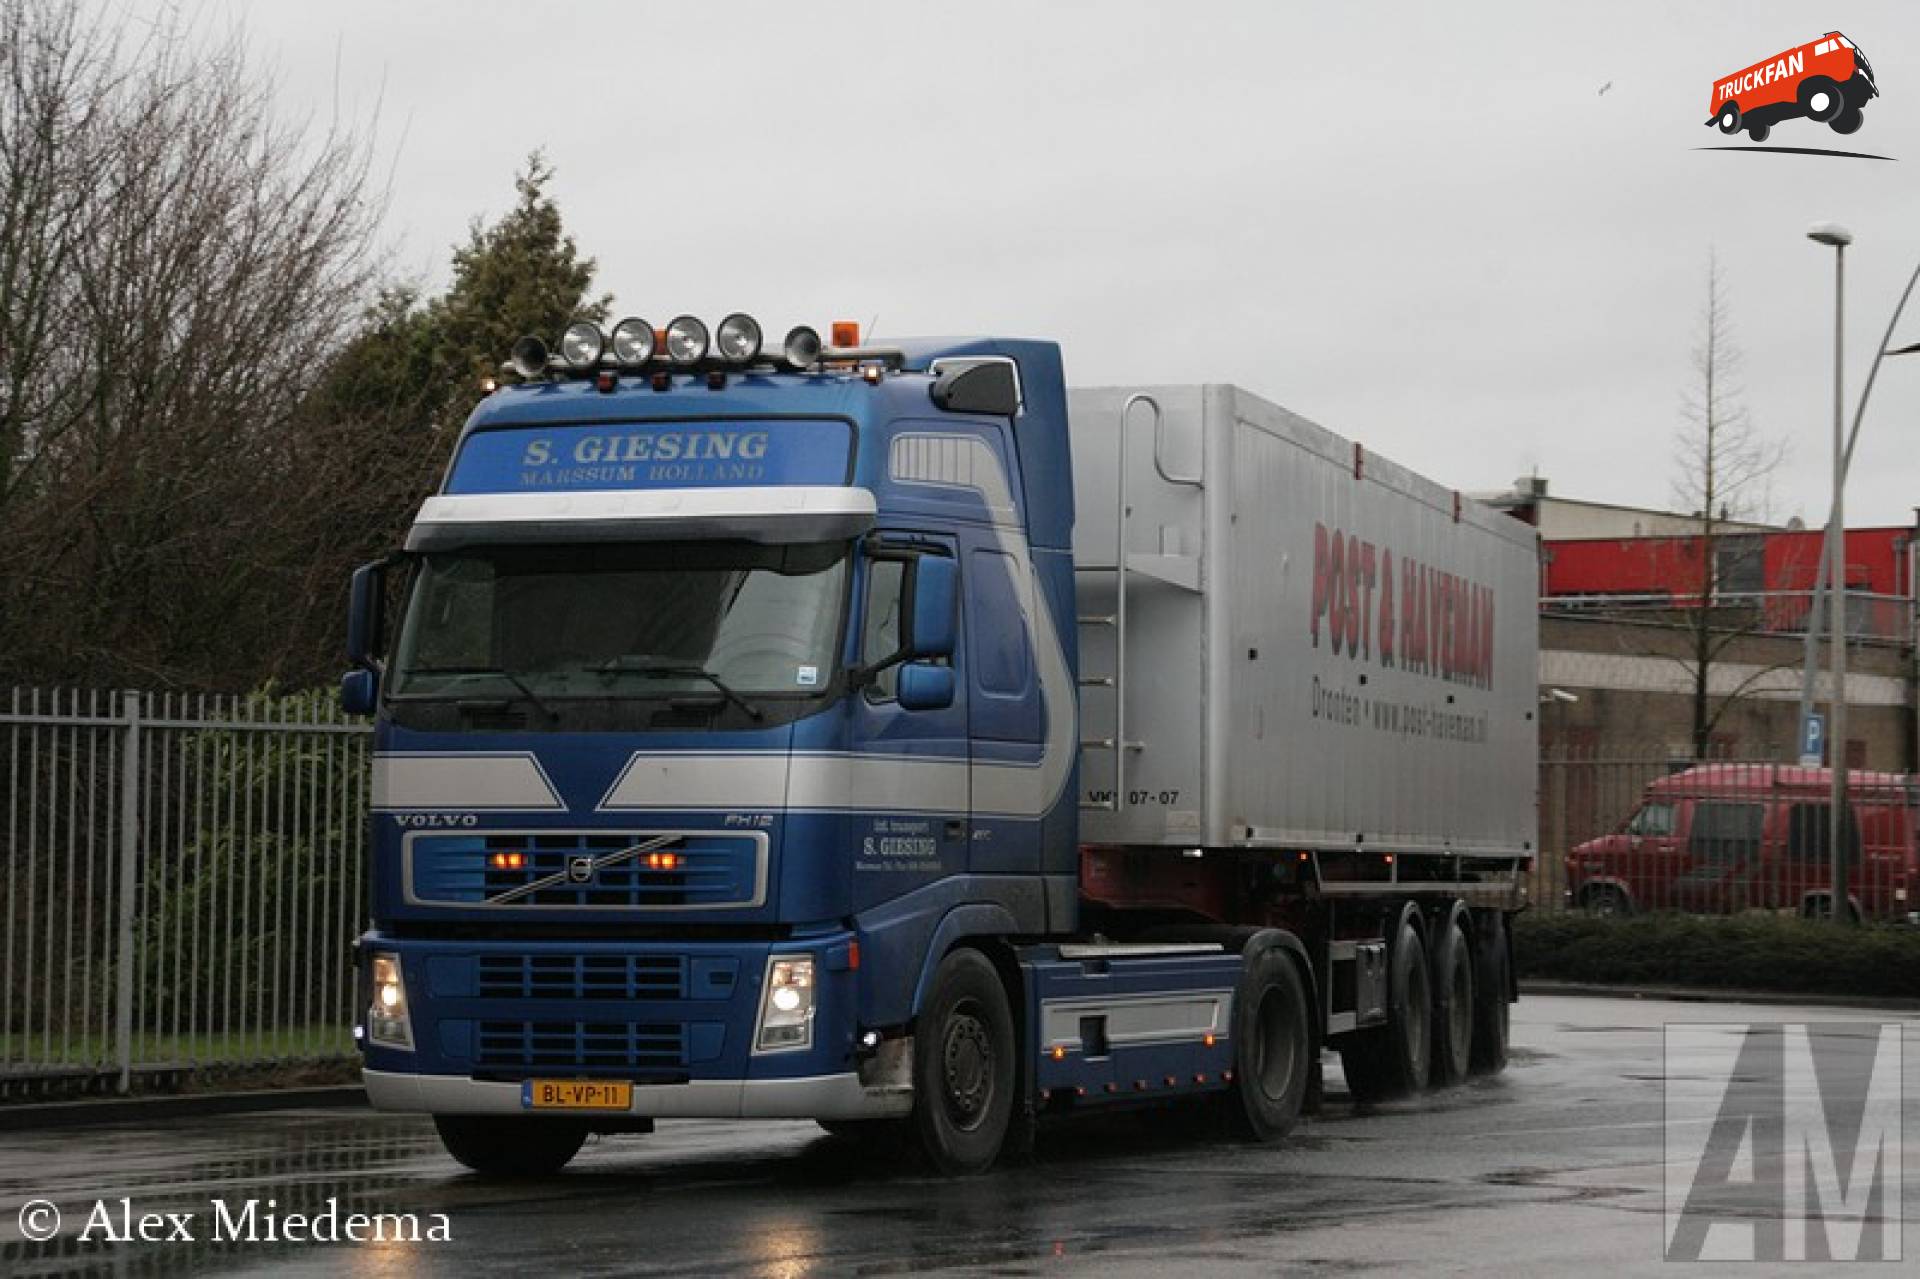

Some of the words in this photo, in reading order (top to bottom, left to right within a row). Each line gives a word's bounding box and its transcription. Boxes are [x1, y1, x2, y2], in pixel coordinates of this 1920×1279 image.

[522, 438, 558, 466] S.
[574, 431, 768, 462] GIESING
[520, 465, 635, 486] MARSSUM
[649, 463, 766, 481] HOLLAND
[1310, 521, 1376, 662] POST
[1378, 547, 1396, 668] &
[1807, 719, 1820, 752] P
[395, 815, 478, 827] VOLVO
[880, 837, 937, 855] GIESING
[543, 1084, 618, 1105] BL-VP-11
